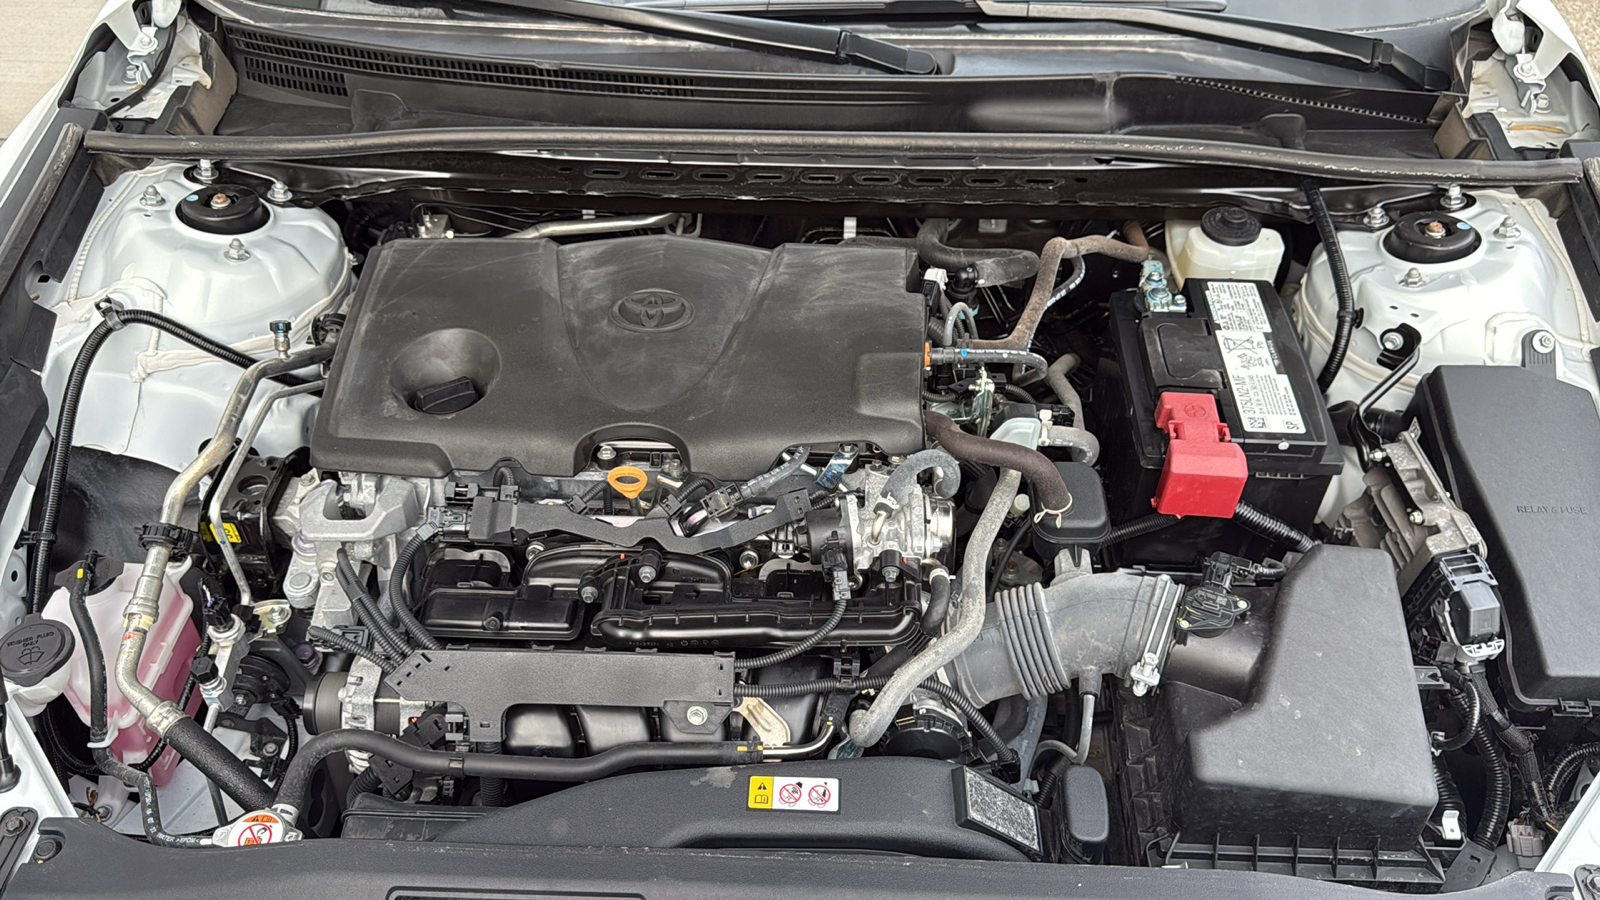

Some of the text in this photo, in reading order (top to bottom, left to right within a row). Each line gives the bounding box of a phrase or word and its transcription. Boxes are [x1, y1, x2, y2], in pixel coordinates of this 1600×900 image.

[1232, 375, 1257, 415] 375LN2-MF
[1285, 421, 1300, 430] SP
[1516, 505, 1548, 514] RELAY
[1560, 506, 1588, 515] FUSE
[7, 637, 33, 647] WASHER
[22, 640, 39, 648] ONLY
